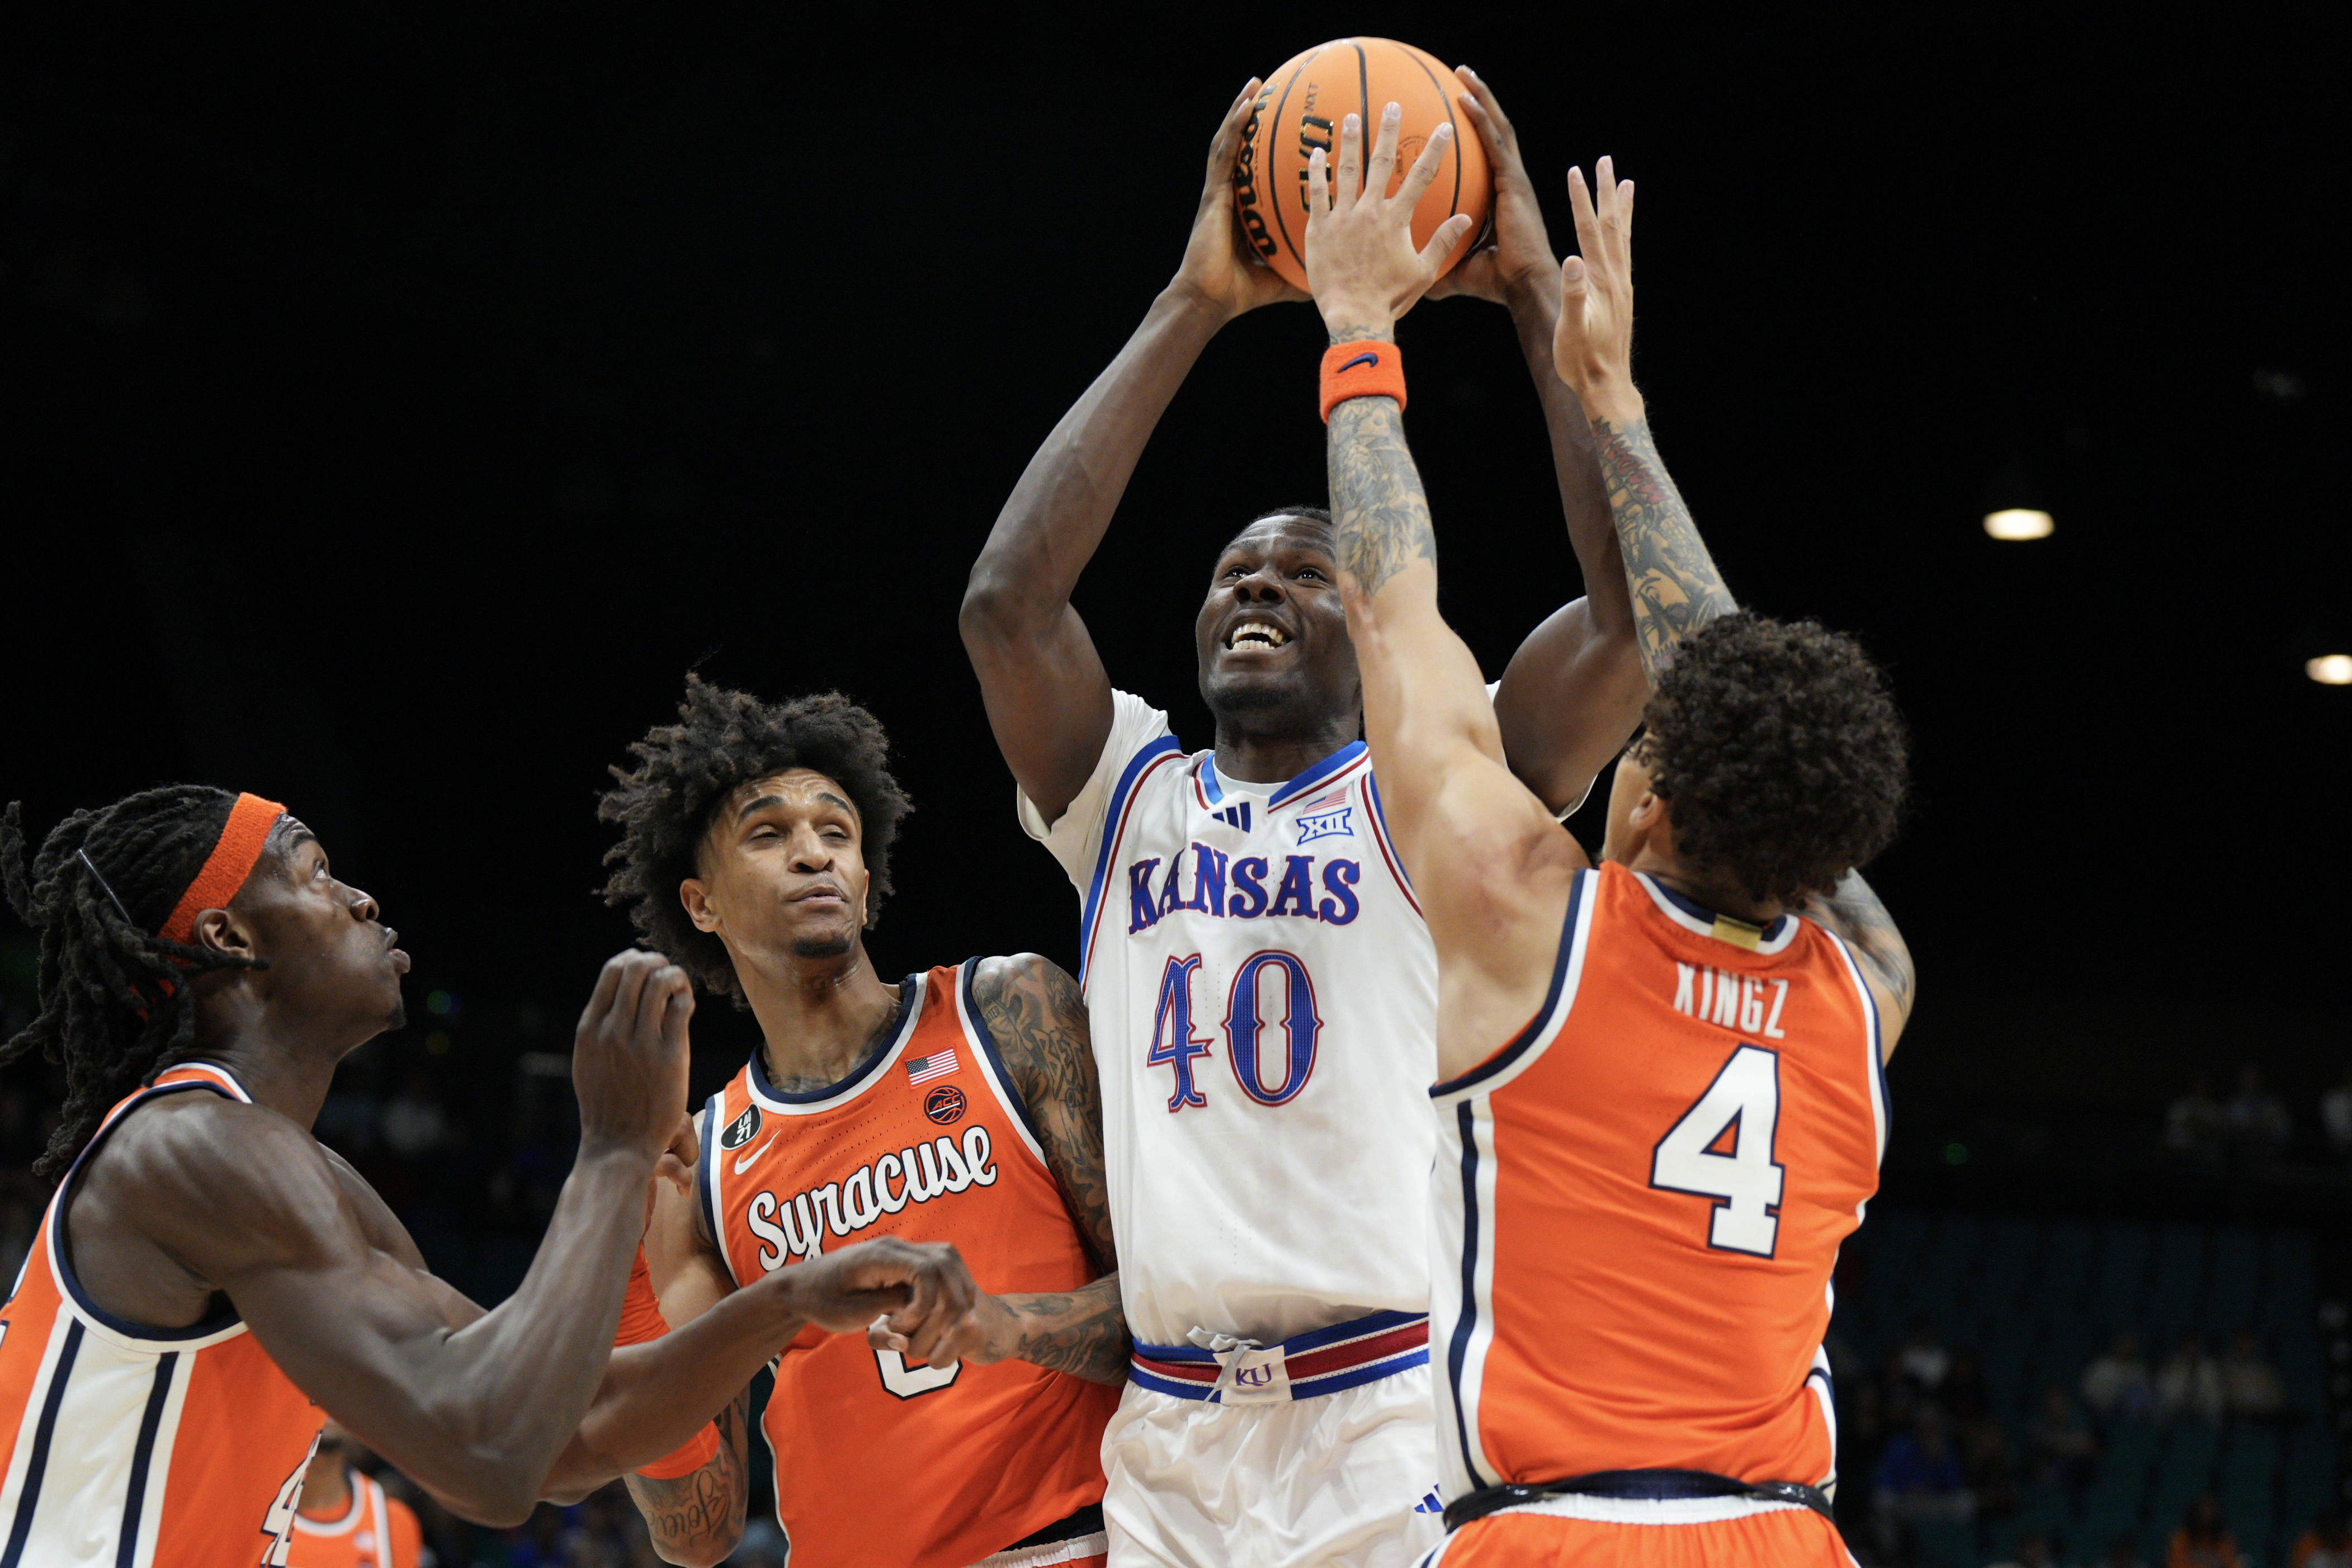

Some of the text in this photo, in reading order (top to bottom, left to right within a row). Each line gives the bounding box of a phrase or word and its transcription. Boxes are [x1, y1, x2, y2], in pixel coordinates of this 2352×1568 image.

[1303, 82, 1318, 112] NXT
[1128, 842, 1360, 935] KANSAS
[1147, 949, 1324, 1113] 40
[932, 1092, 961, 1111] ACC
[738, 1109, 752, 1130] LM
[734, 1125, 751, 1145] 21
[1648, 1042, 1786, 1260] 4
[747, 1125, 998, 1273] Syracuse
[1235, 1363, 1272, 1386] KU
